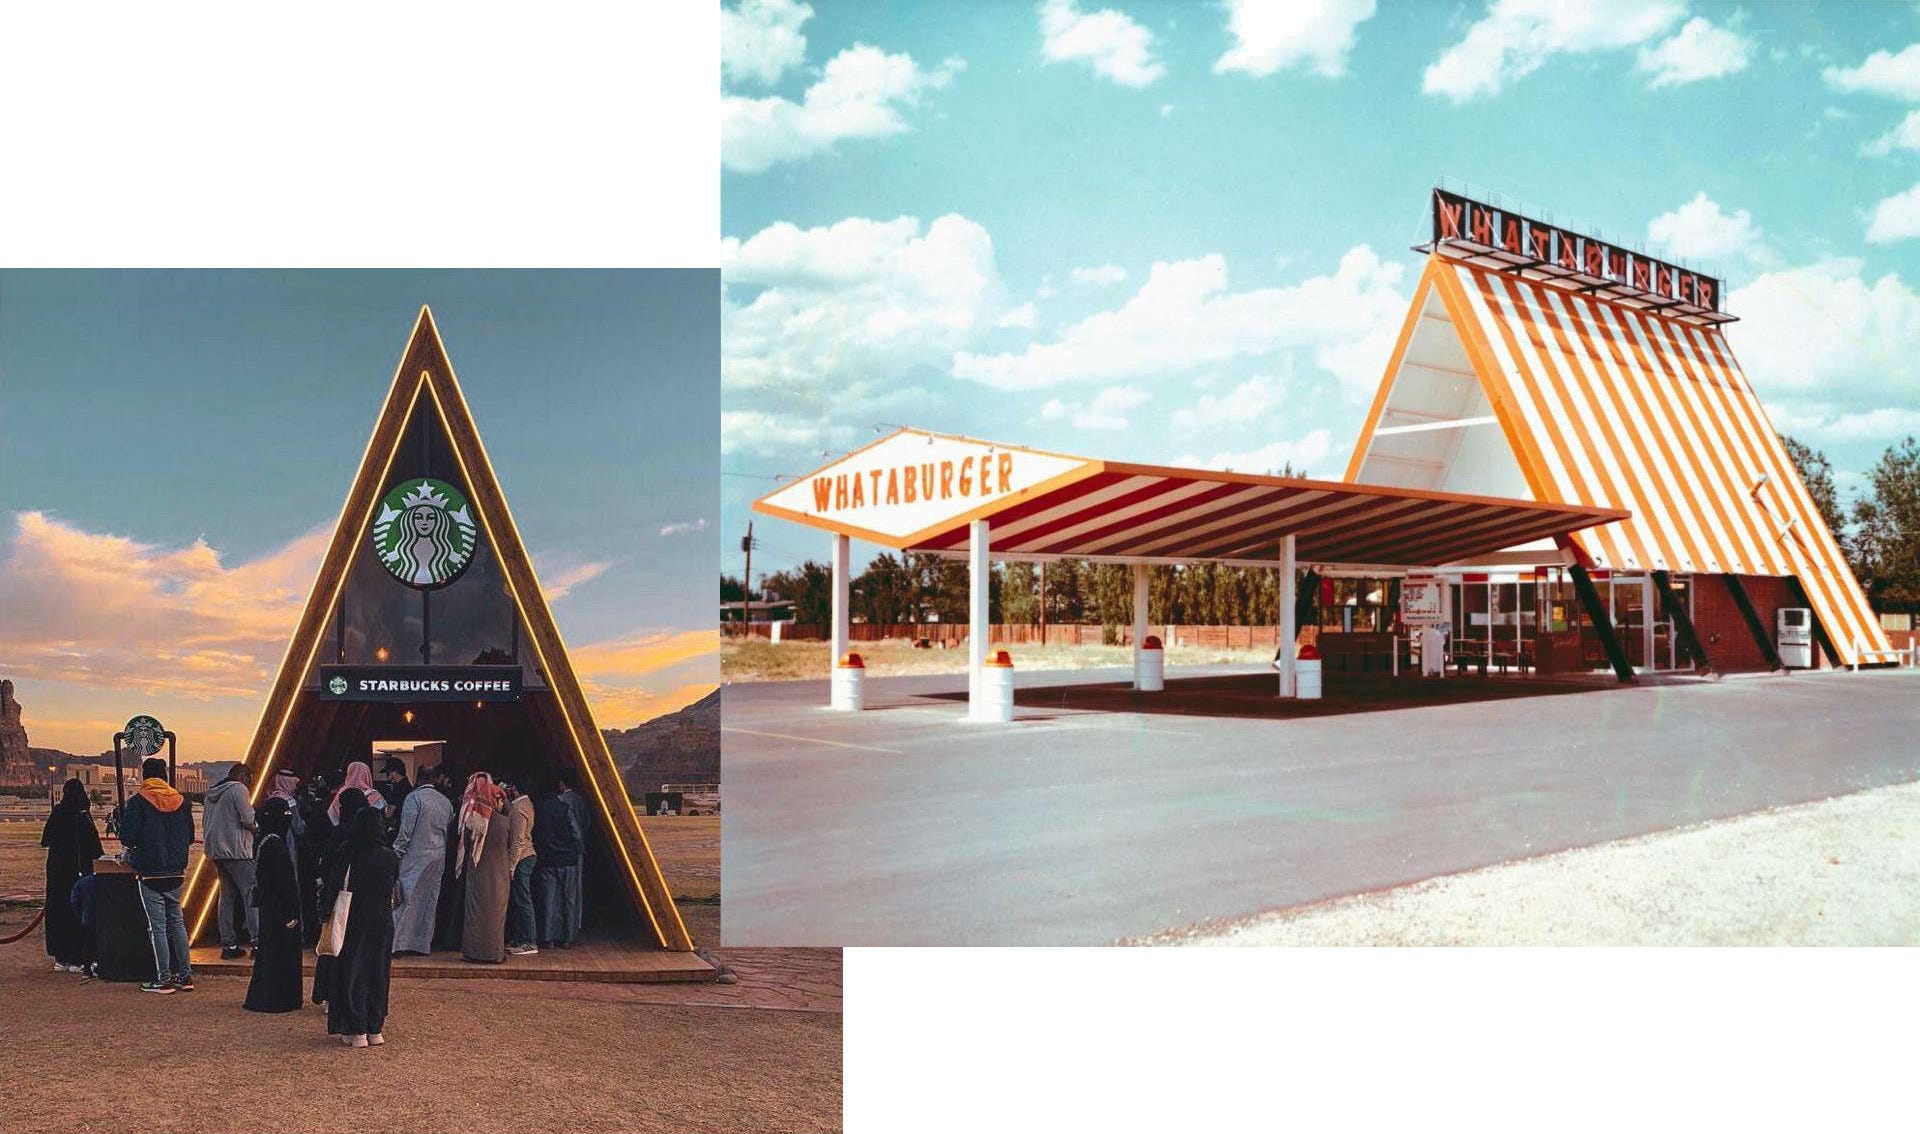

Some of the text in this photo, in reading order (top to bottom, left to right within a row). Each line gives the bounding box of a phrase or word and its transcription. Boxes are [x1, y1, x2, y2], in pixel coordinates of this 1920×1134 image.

[1438, 202, 1713, 310] WHATABURGER
[813, 453, 1012, 512] WHATABURGER
[359, 680, 511, 692] STARBUCKS COFFEE
